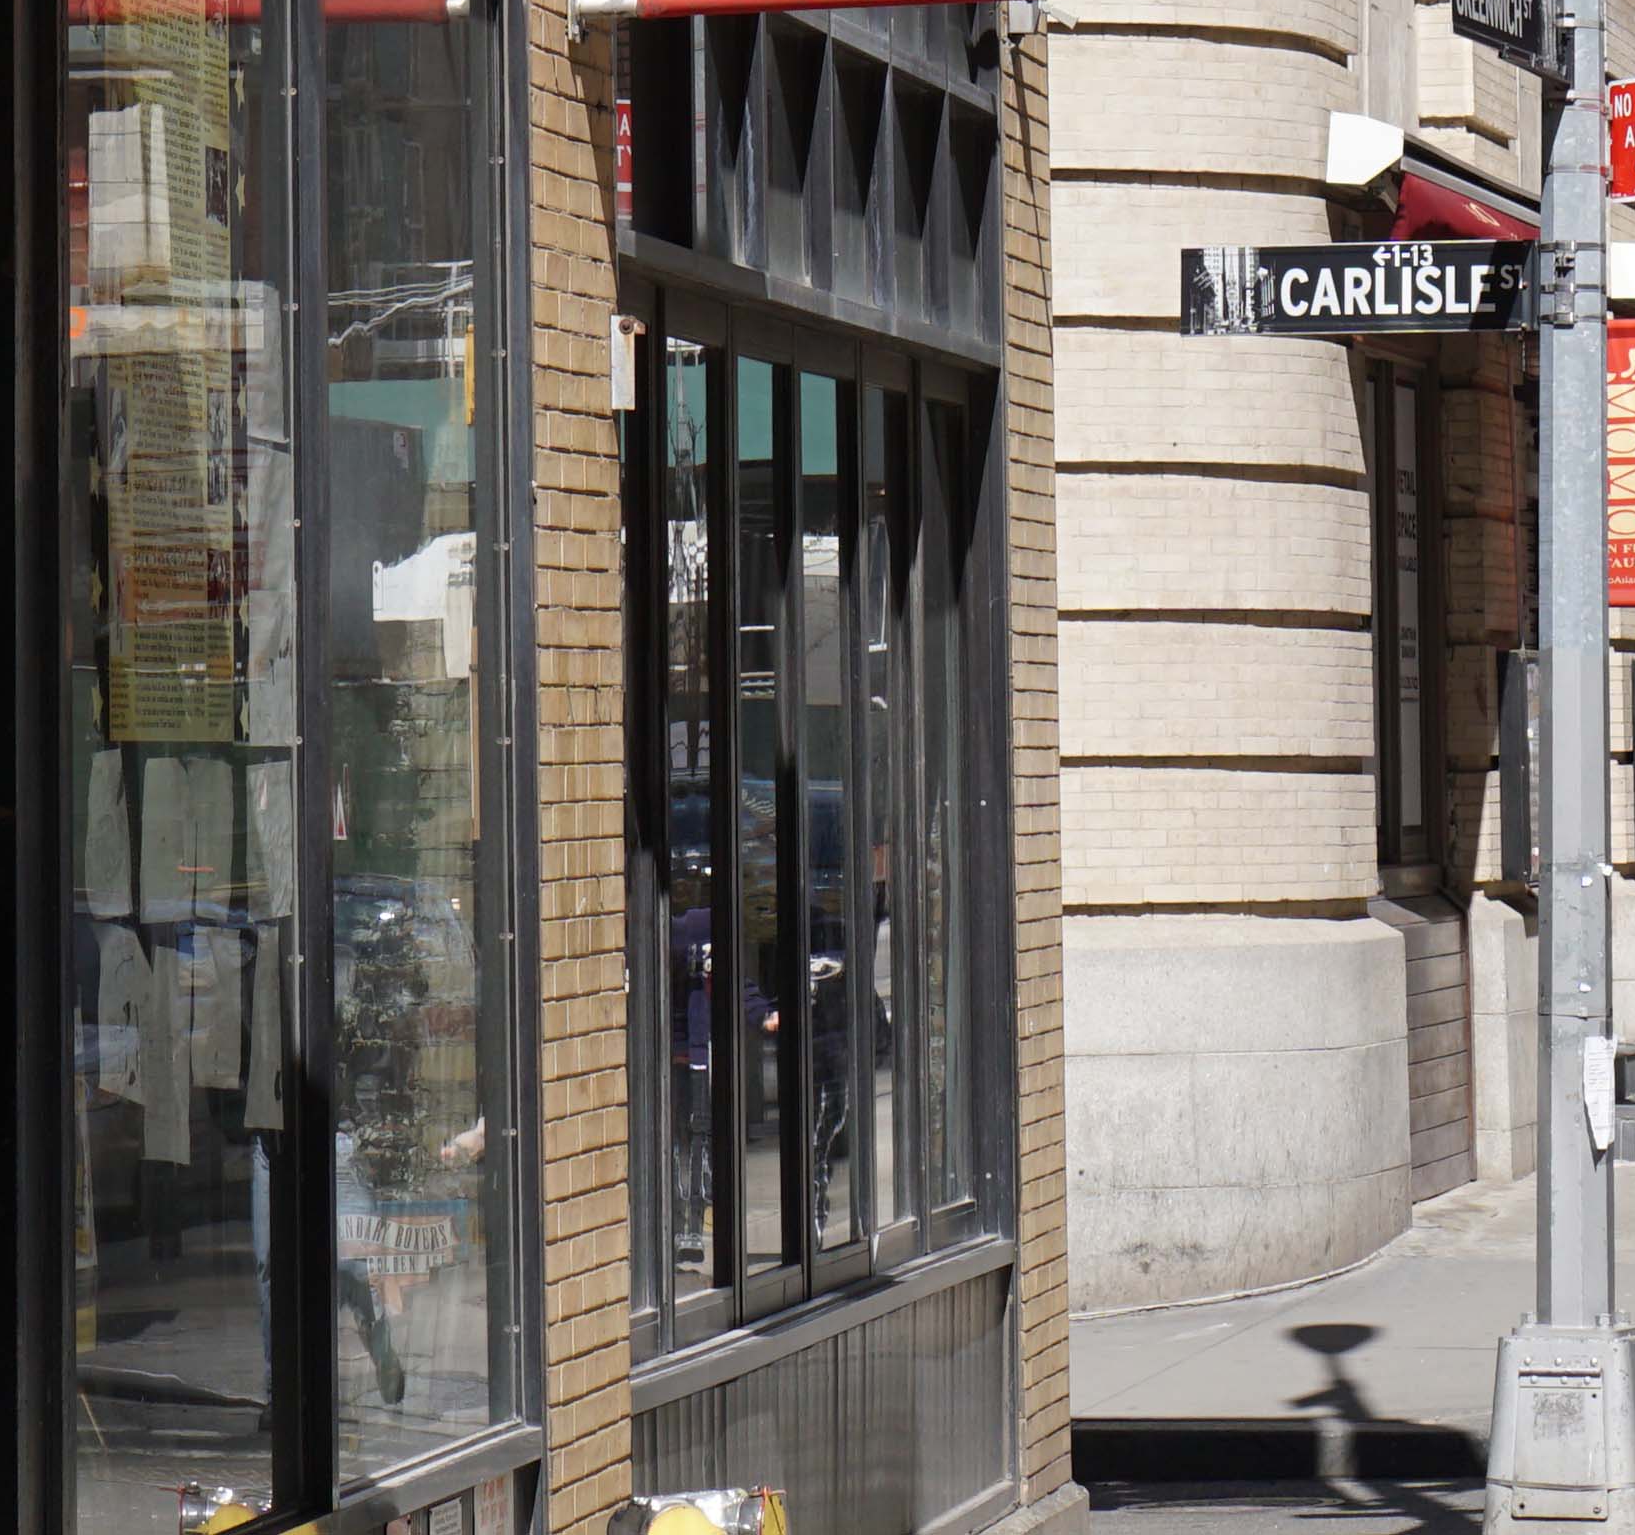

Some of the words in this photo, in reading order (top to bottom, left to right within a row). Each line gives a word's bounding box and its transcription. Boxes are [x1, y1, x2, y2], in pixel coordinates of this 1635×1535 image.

[1613, 92, 1633, 119] NO
[1391, 244, 1434, 268] 1-13
[1279, 264, 1497, 317] CARLISLE
[395, 1223, 449, 1252] BOXERS
